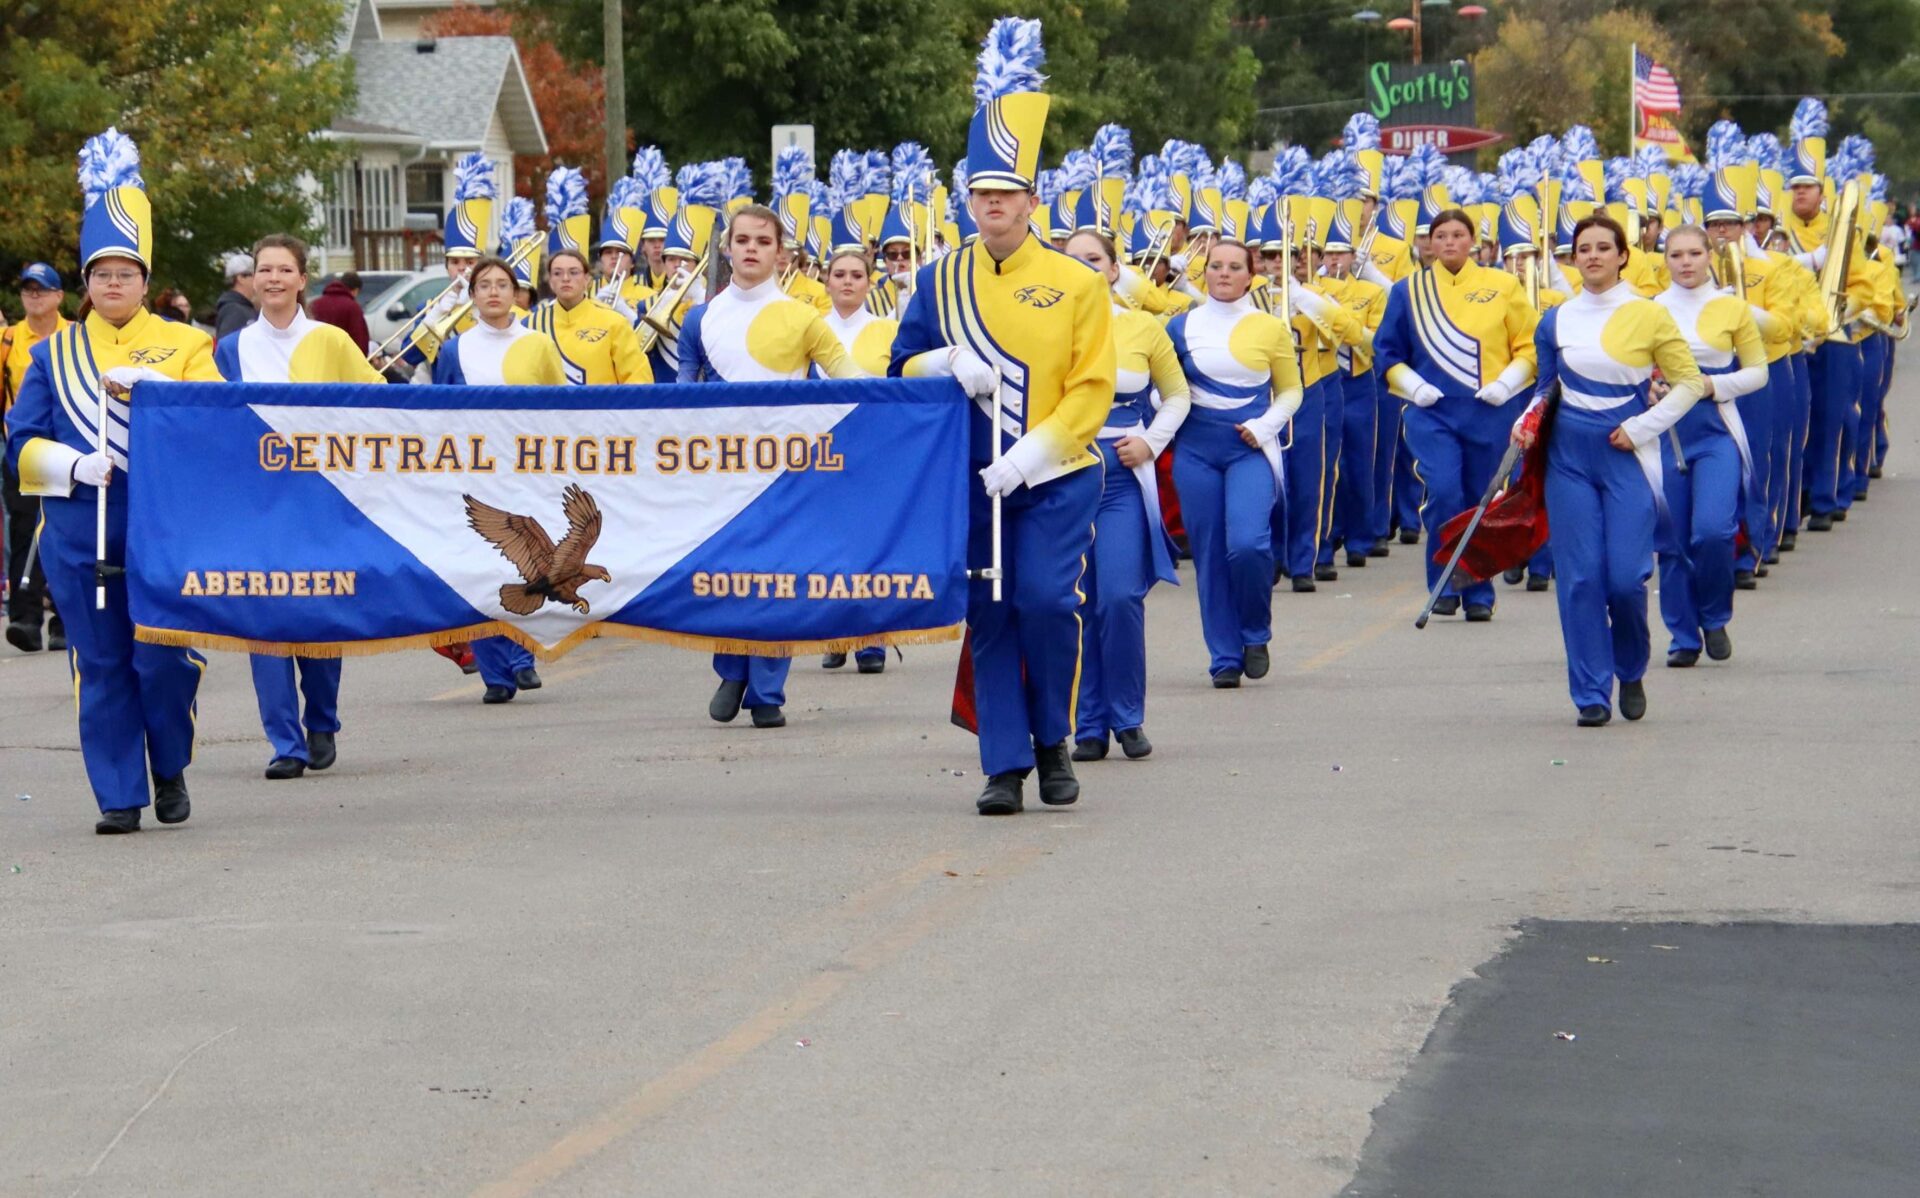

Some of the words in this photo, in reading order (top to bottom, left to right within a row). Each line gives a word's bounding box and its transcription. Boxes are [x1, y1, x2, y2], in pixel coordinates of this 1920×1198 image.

[1370, 61, 1470, 119] Scotty's
[1391, 130, 1449, 149] DINER
[259, 432, 497, 474] CENTRAL
[514, 433, 638, 474] HIGH
[655, 432, 845, 474] SCHOOL
[180, 570, 357, 597] ABERDEEN
[691, 571, 798, 599] SOUTH
[807, 573, 936, 600] DAKOTA
